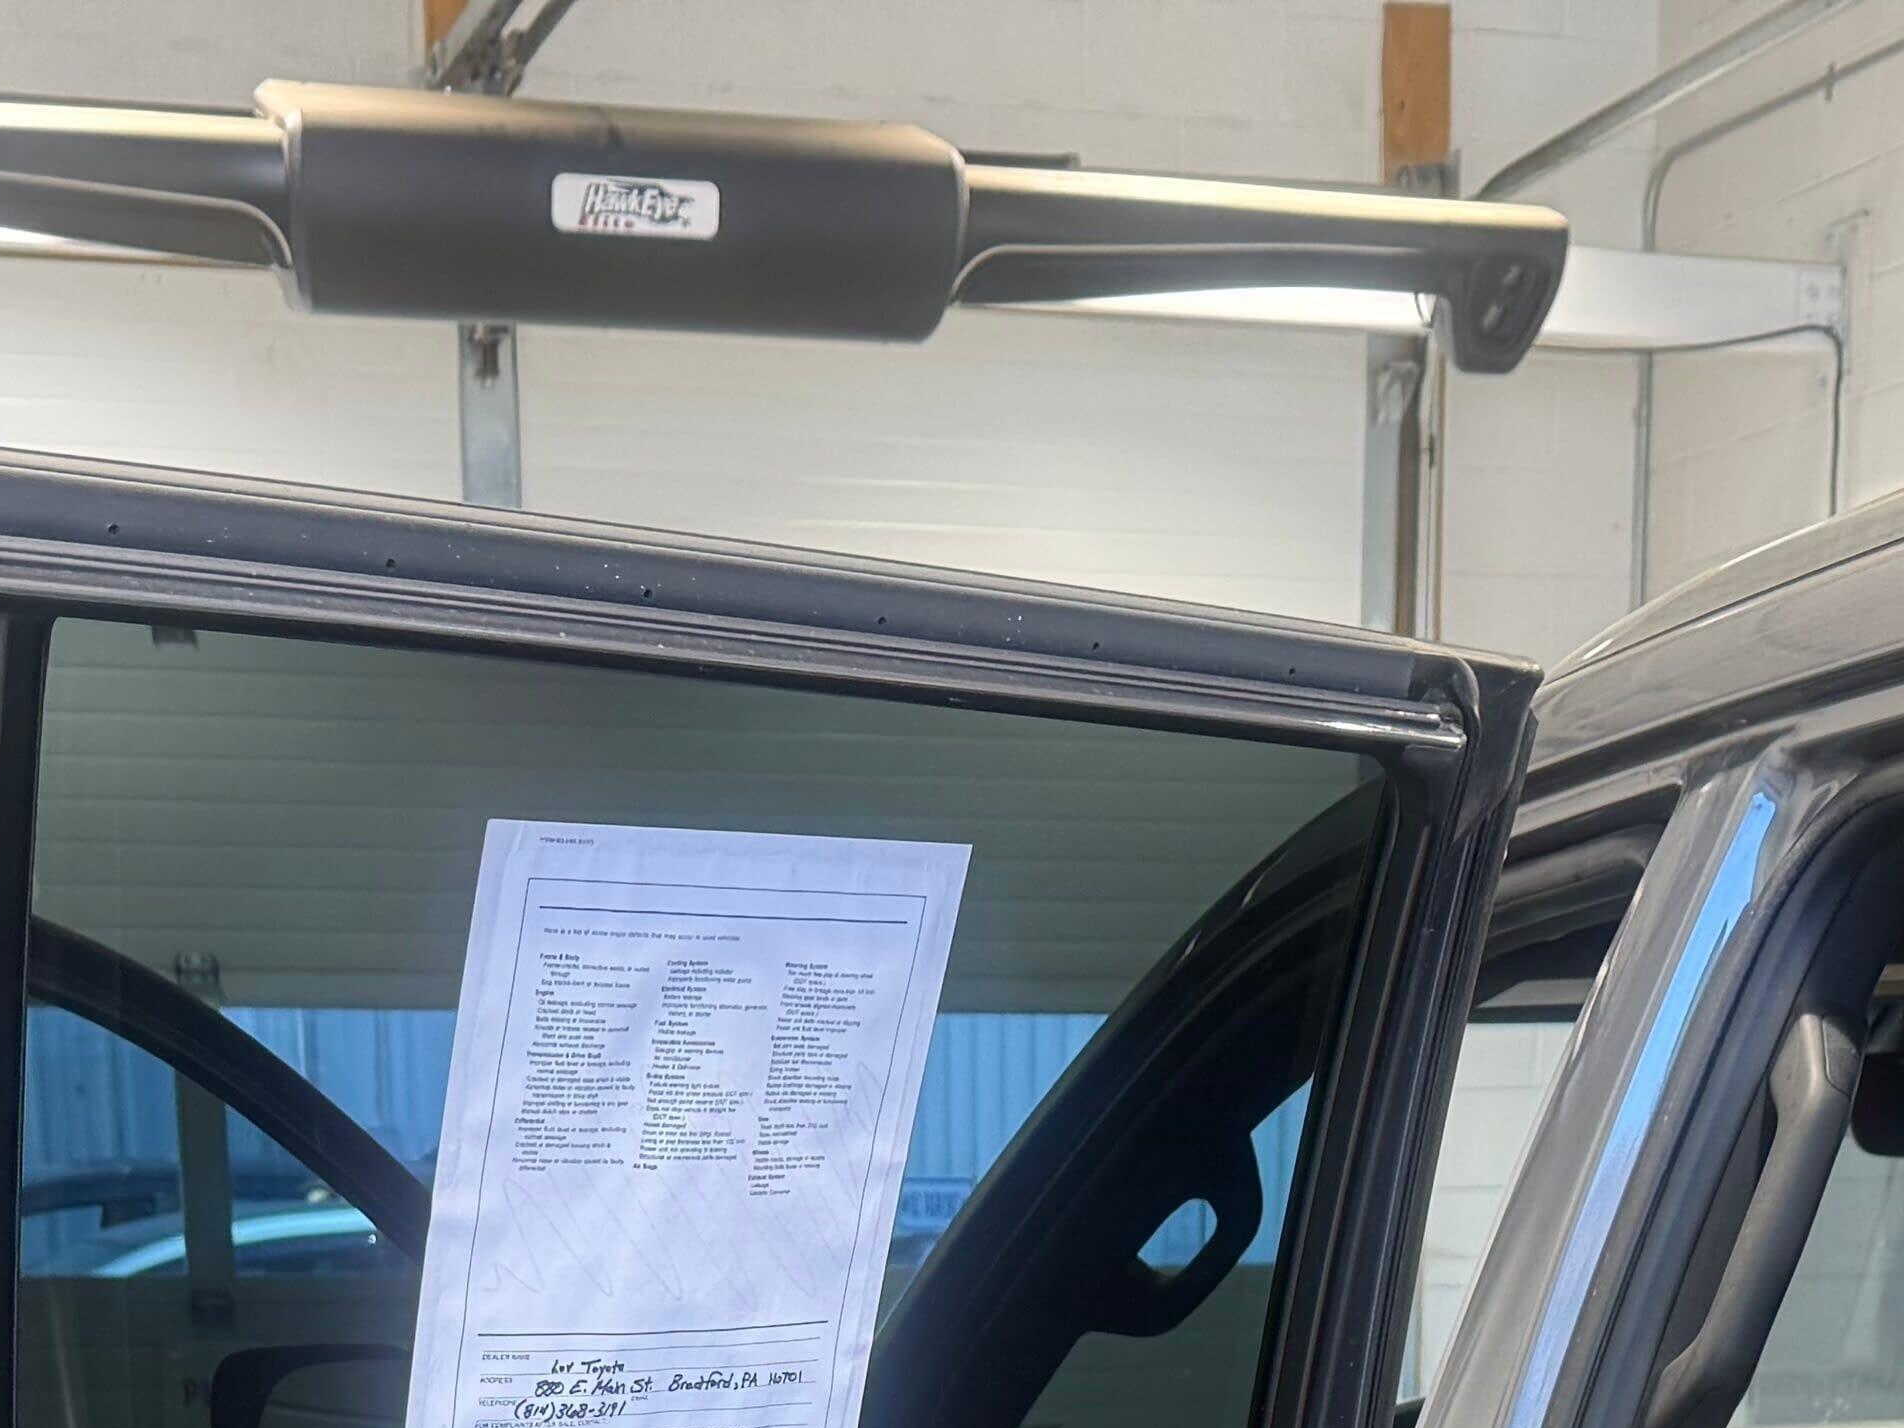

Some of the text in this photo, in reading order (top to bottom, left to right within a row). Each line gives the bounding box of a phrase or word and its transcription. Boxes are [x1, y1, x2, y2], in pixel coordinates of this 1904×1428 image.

[581, 1358, 625, 1380] Toyota
[569, 1379, 587, 1395] E.
[591, 1378, 626, 1395] Main
[630, 1376, 653, 1393] St.
